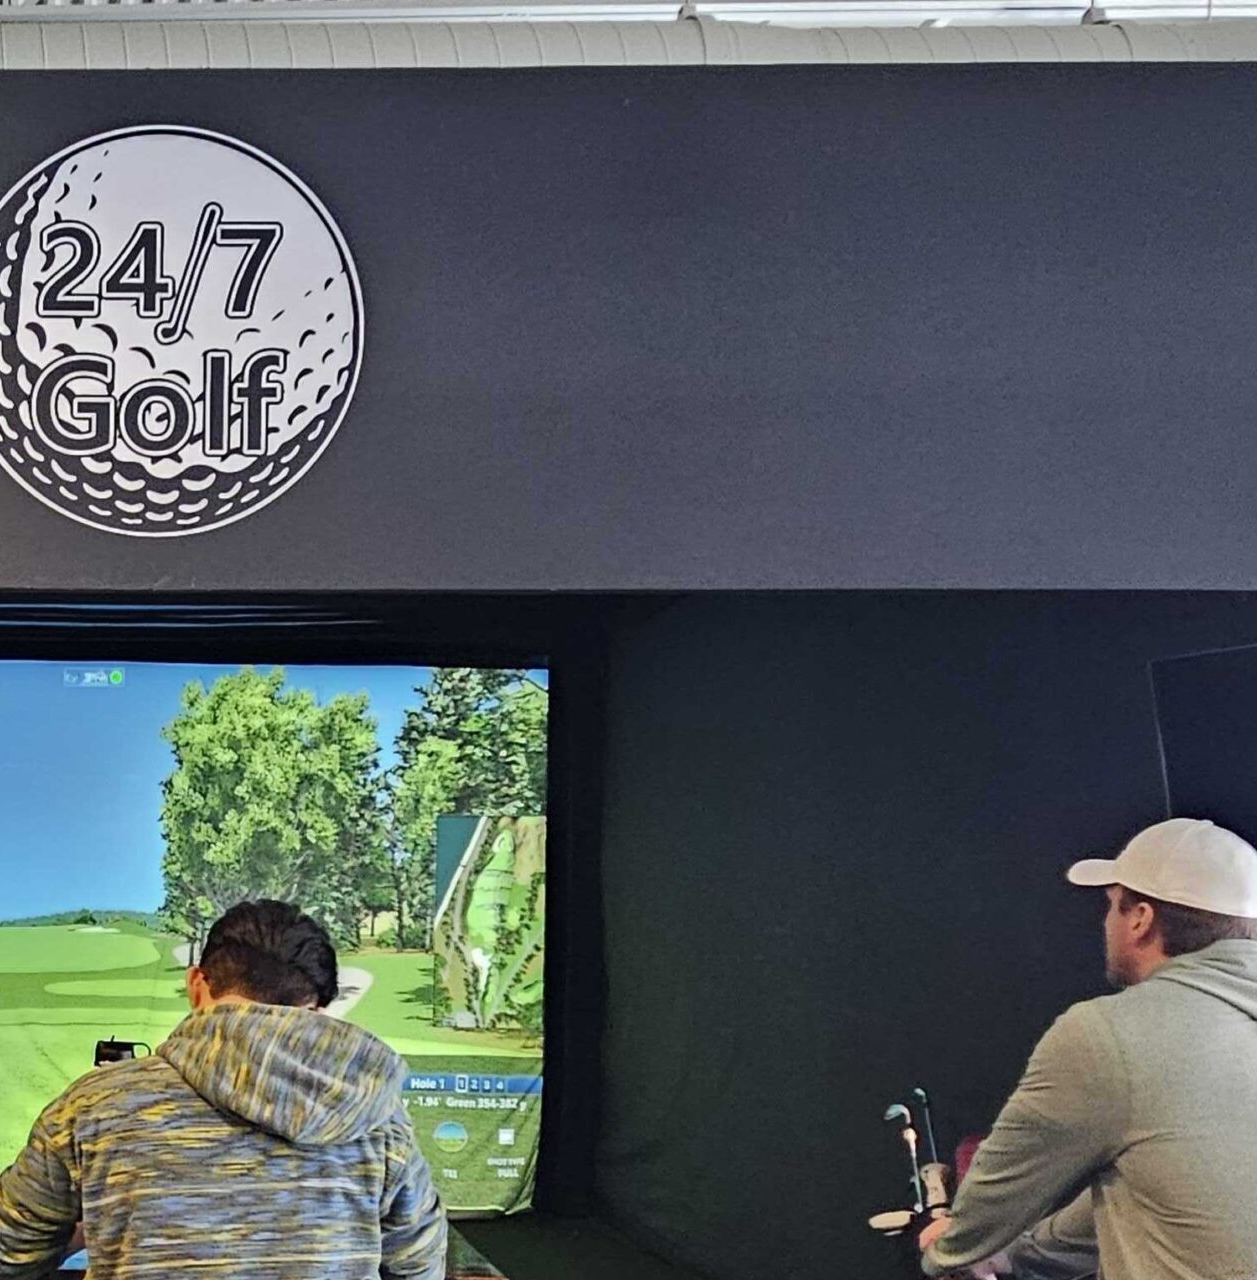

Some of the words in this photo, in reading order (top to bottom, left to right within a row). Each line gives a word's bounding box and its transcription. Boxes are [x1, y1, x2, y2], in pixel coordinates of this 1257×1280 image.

[35, 201, 283, 344] 24/7
[31, 348, 287, 456] Golf
[410, 1077, 437, 1090] Hole
[438, 1077, 445, 1090] 1
[446, 1096, 476, 1109] Green
